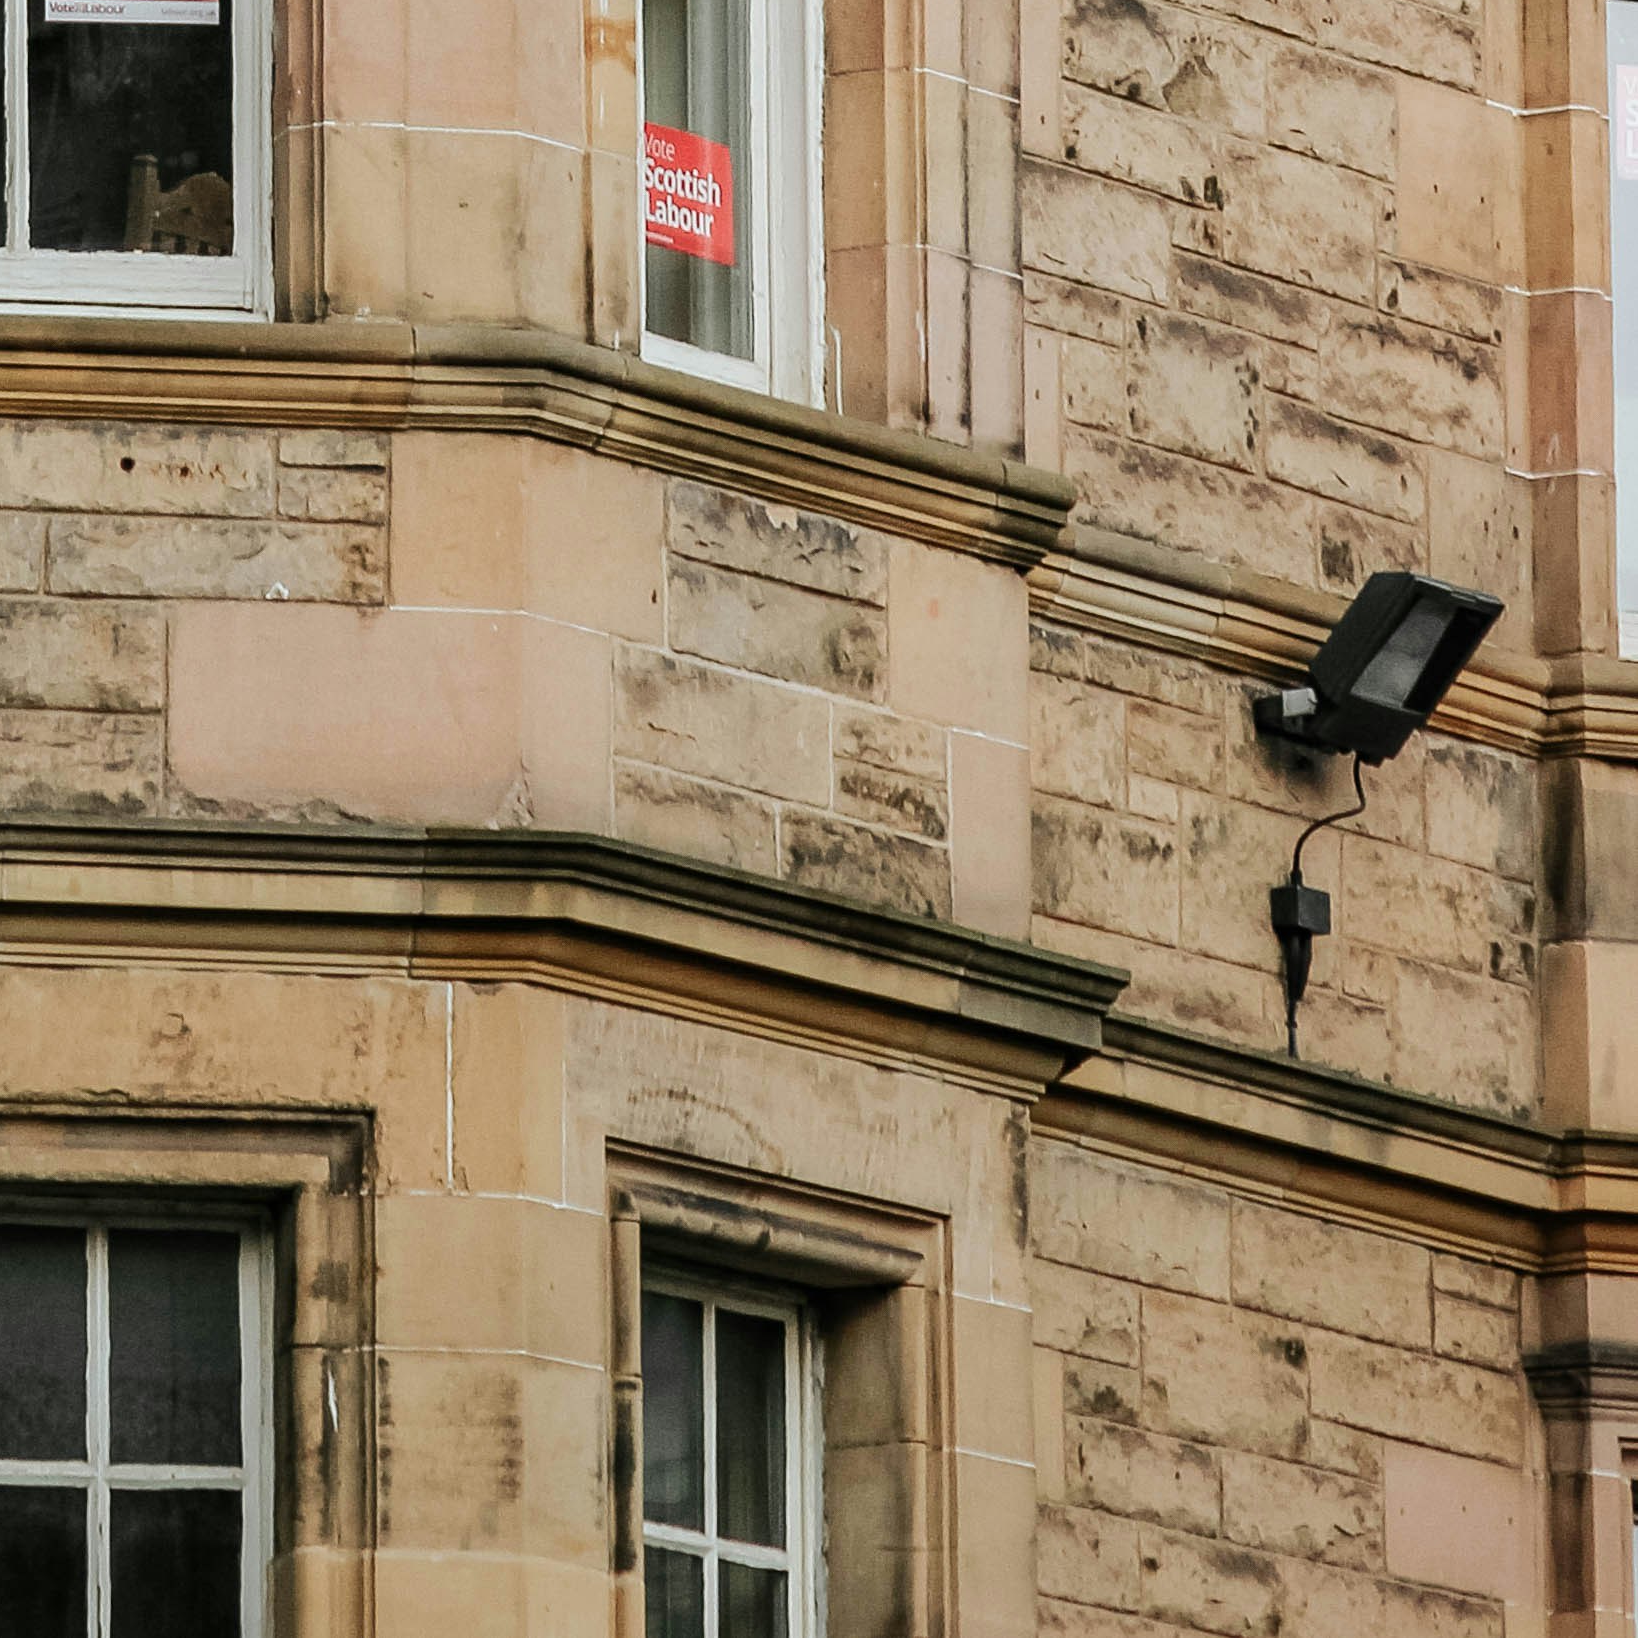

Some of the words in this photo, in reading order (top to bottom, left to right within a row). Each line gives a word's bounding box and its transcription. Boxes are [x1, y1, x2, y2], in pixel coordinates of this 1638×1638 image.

[49, 2, 74, 13] Vote
[85, 4, 125, 14] Labour
[642, 157, 721, 207] Scottish
[644, 189, 714, 238] Labour
